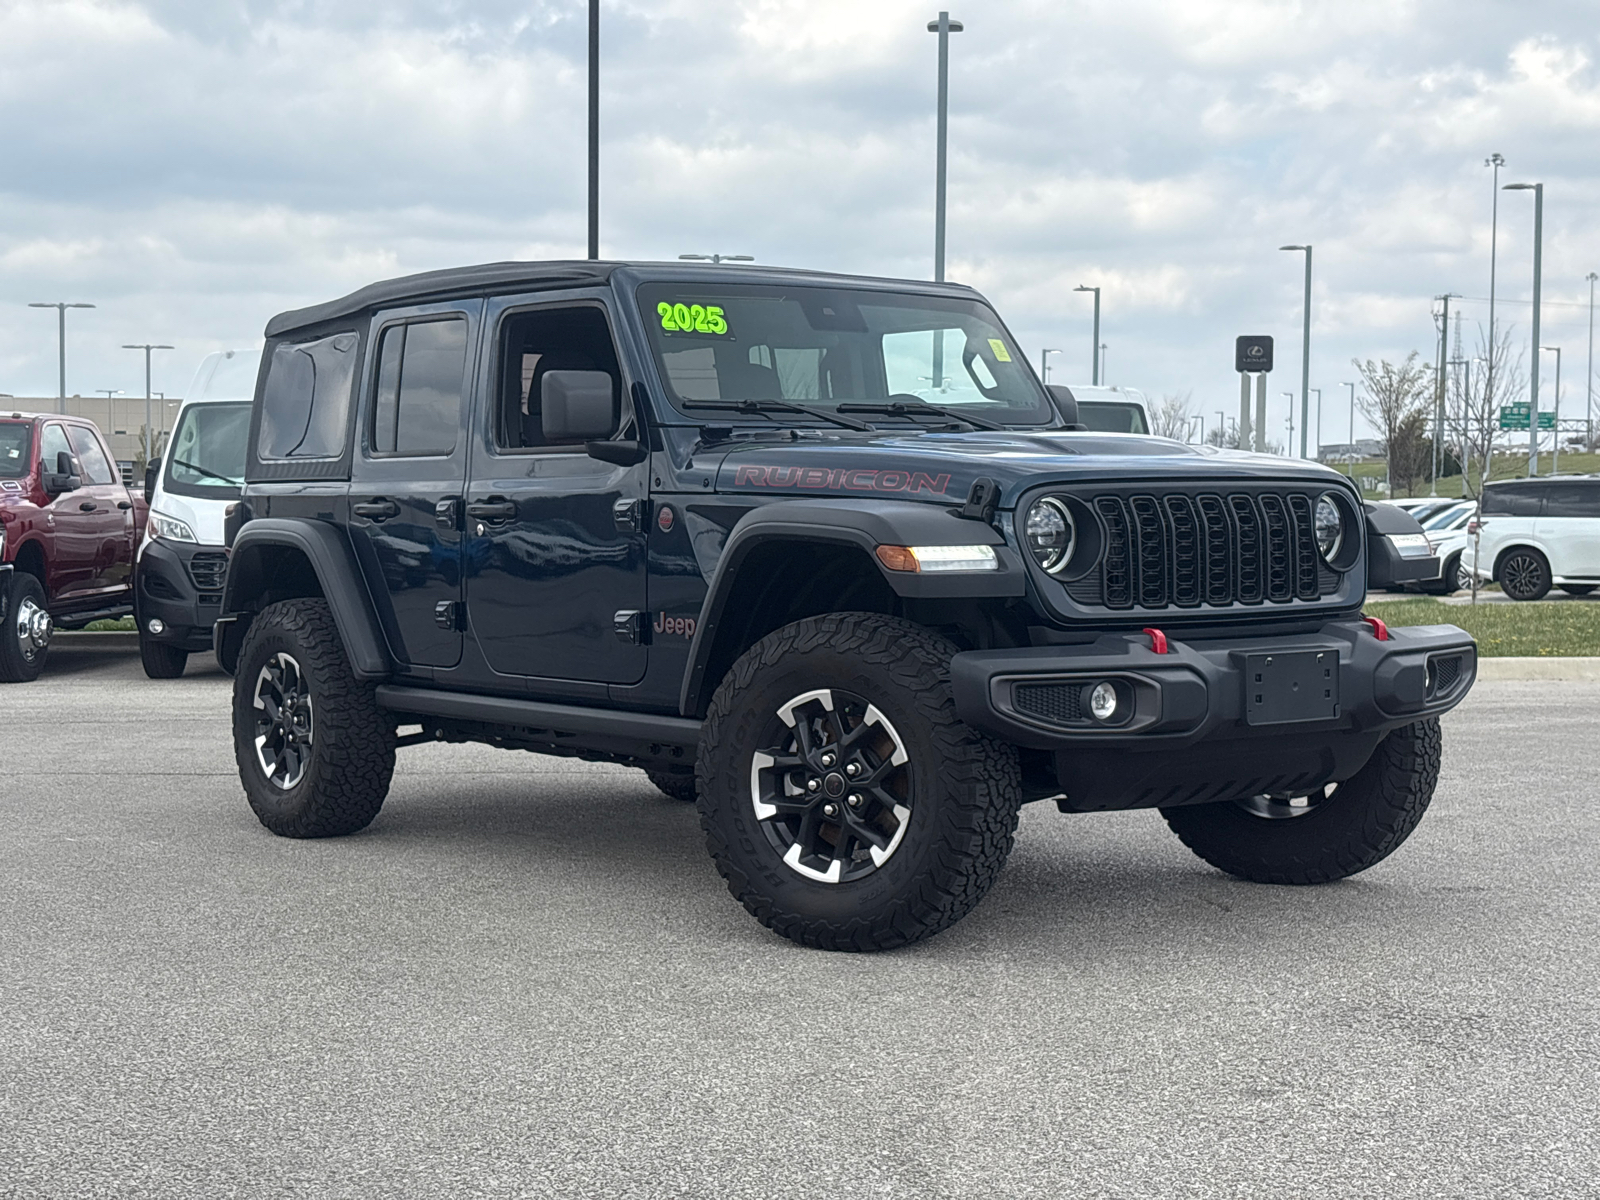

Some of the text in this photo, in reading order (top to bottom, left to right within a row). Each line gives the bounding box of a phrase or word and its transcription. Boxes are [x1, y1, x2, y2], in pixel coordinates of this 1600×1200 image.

[657, 302, 728, 334] 2025
[735, 465, 951, 494] RUBICON
[653, 611, 696, 640] Jeep
